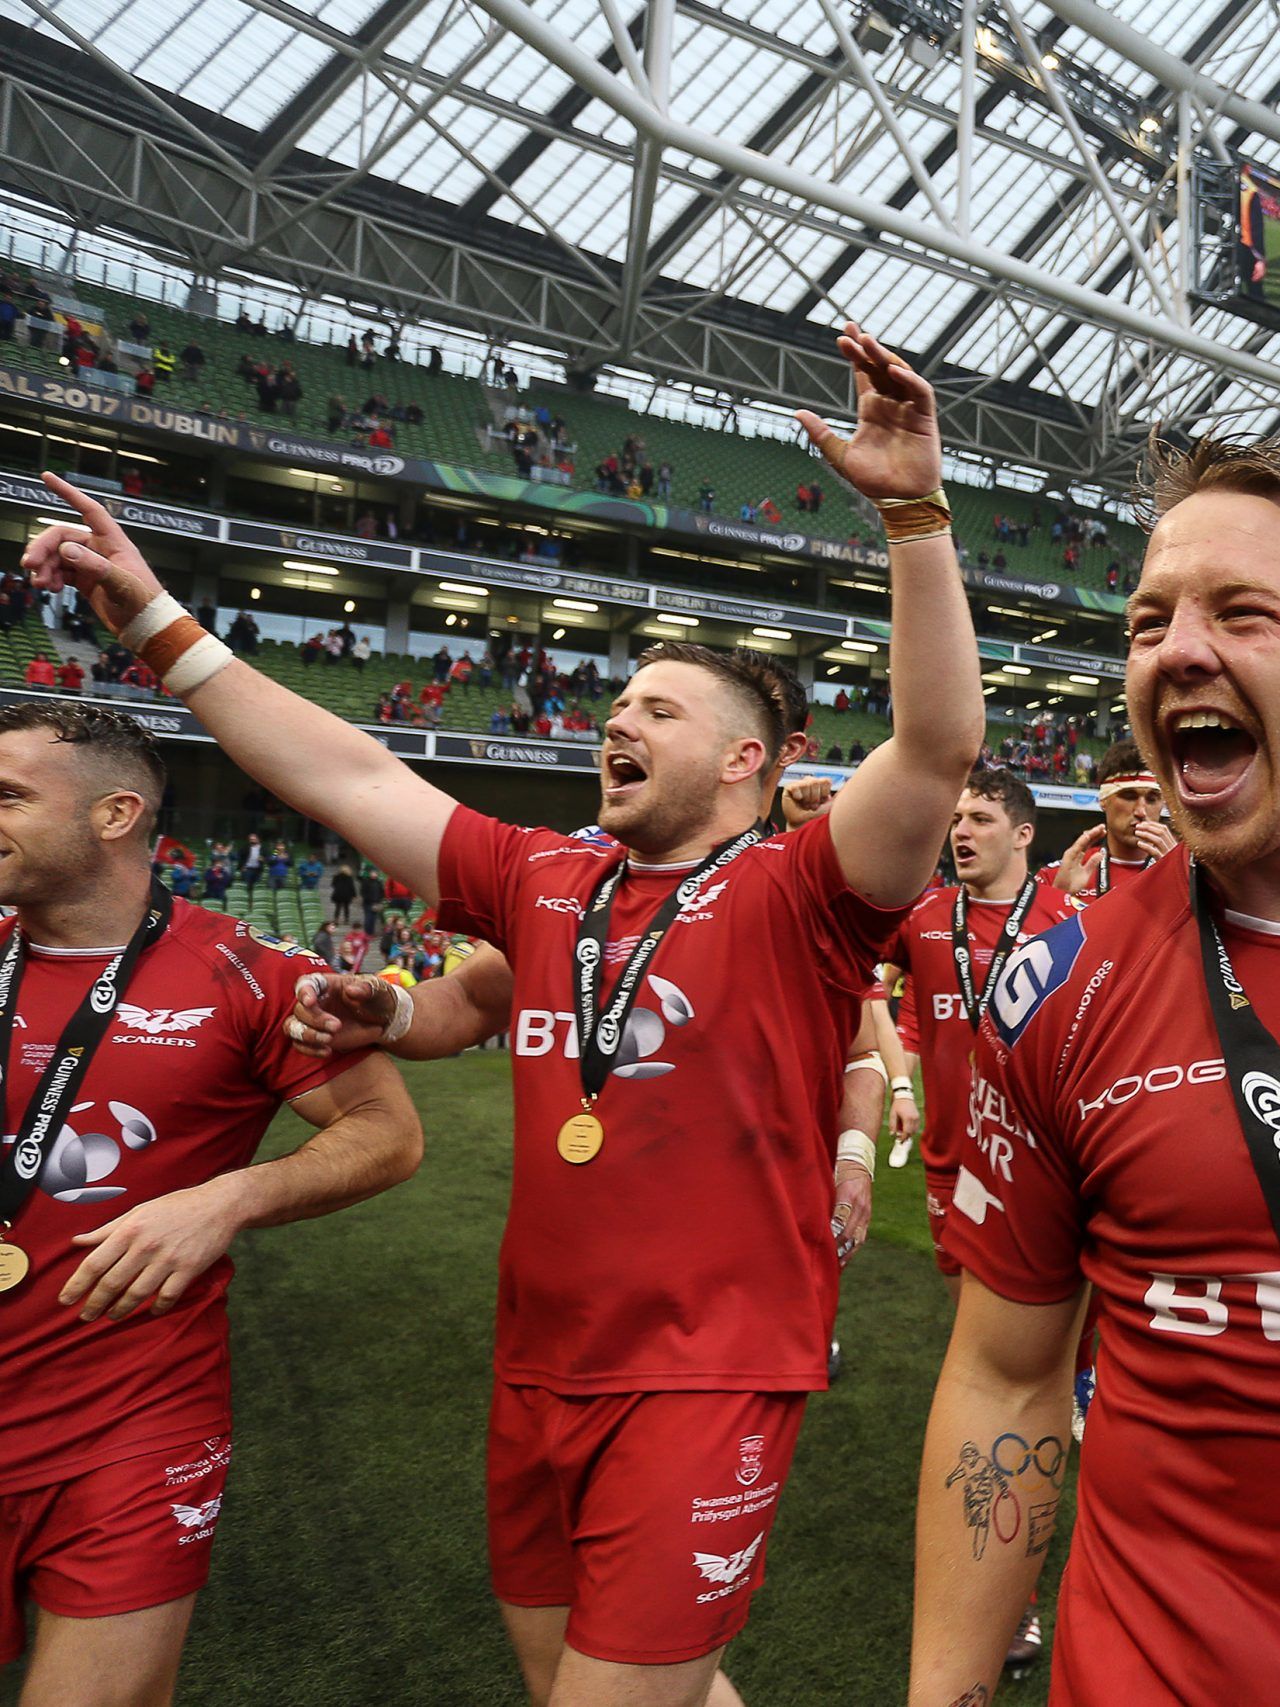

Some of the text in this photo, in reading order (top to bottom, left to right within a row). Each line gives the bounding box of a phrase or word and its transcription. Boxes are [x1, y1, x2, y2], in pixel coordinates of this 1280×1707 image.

[43, 383, 119, 415] 2017
[129, 402, 239, 446] DUBLIN
[268, 438, 405, 477] GUINNESS PRO12
[122, 505, 204, 533] GUINNESS
[708, 522, 759, 543] GUINNESS
[296, 535, 368, 560] GUINNESS
[810, 540, 890, 568] FINAL 20
[563, 577, 645, 601] FINAL 2017
[984, 575, 1023, 591] GUINNESS
[656, 591, 706, 611] DUBLIN
[486, 742, 559, 764] GUINNESS
[621, 938, 658, 990] GUINNESS
[90, 954, 124, 1013] PRO12
[240, 967, 266, 1000] MOTORS
[1075, 959, 1114, 1020] MOTORS
[112, 1034, 197, 1048] SCARLETS
[516, 1009, 580, 1059] BT
[1078, 1058, 1227, 1120] KOOG
[14, 1056, 79, 1180] GUINNESS PRO12
[692, 1493, 743, 1509] Swansea
[178, 1526, 216, 1545] SCARLE
